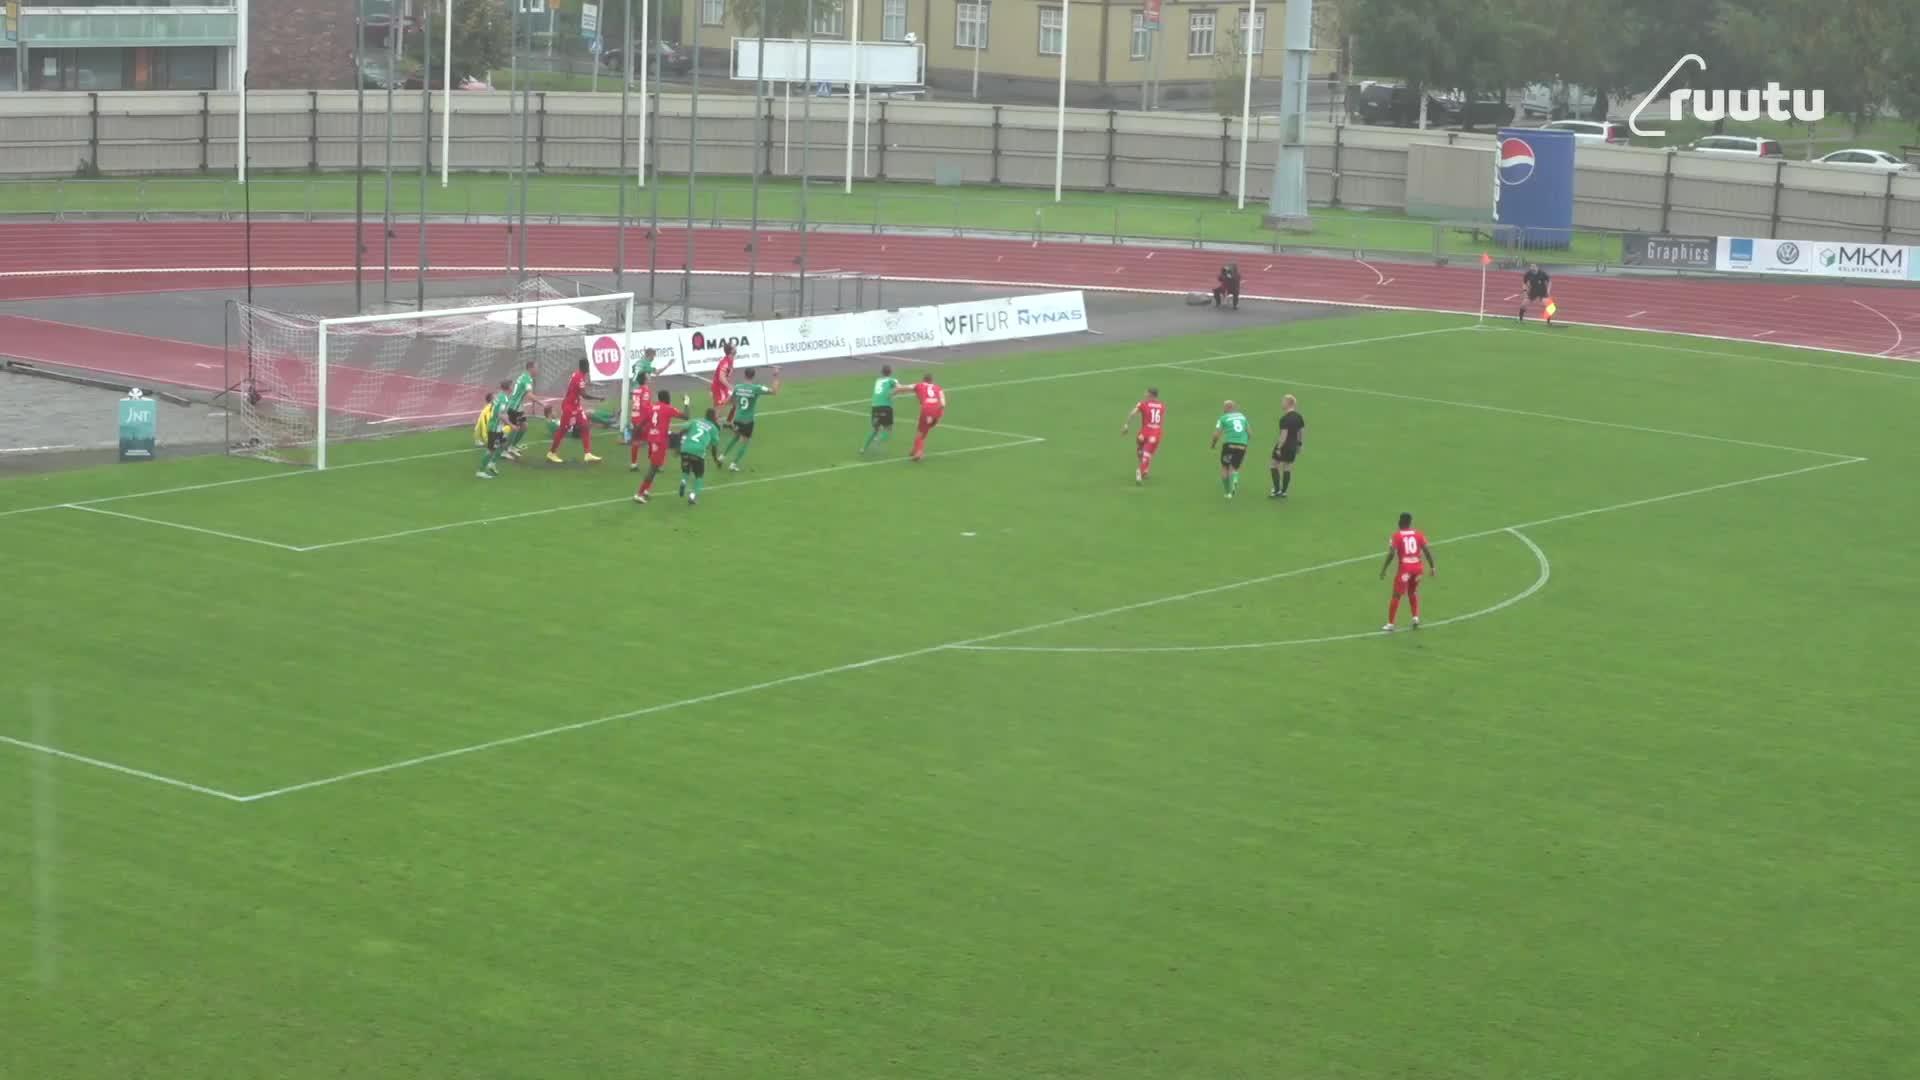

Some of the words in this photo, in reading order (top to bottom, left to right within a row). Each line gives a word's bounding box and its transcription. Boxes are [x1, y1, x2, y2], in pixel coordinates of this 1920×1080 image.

[1648, 241, 1709, 263] Graphics
[1839, 246, 1902, 267] MKM
[960, 310, 1009, 334] FIFUR
[593, 347, 620, 364] BTB
[927, 385, 935, 398] 6
[740, 397, 749, 410] 9
[127, 408, 151, 424] JNT
[651, 411, 658, 427] 4
[1150, 408, 1161, 424] 16
[1233, 420, 1243, 432] 8
[691, 427, 705, 443] 2
[1403, 536, 1418, 554] 10
